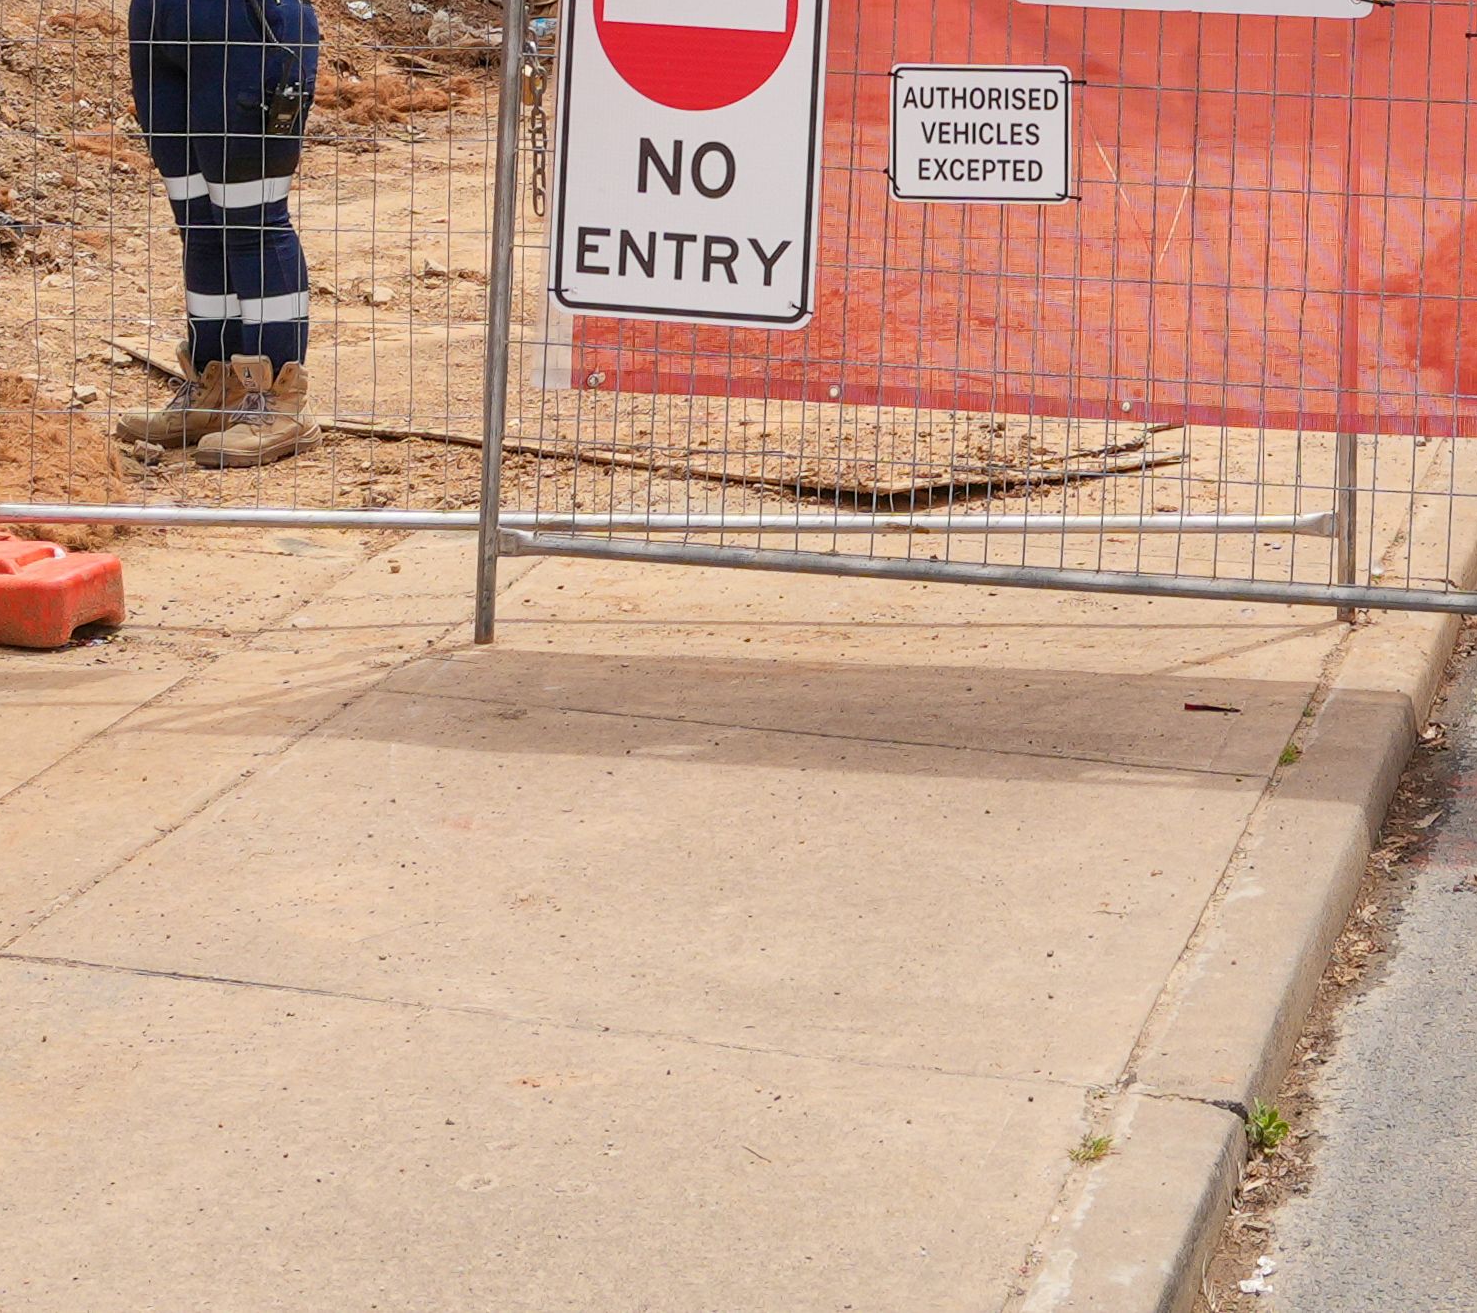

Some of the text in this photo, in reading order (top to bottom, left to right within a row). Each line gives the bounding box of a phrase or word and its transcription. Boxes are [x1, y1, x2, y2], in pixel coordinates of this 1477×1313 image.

[903, 85, 1058, 113] AUTHORISED
[920, 121, 1040, 148] VEHICLES
[637, 138, 736, 198] NO
[917, 157, 1043, 184] EXCEPTED
[575, 227, 793, 287] ENTRY
